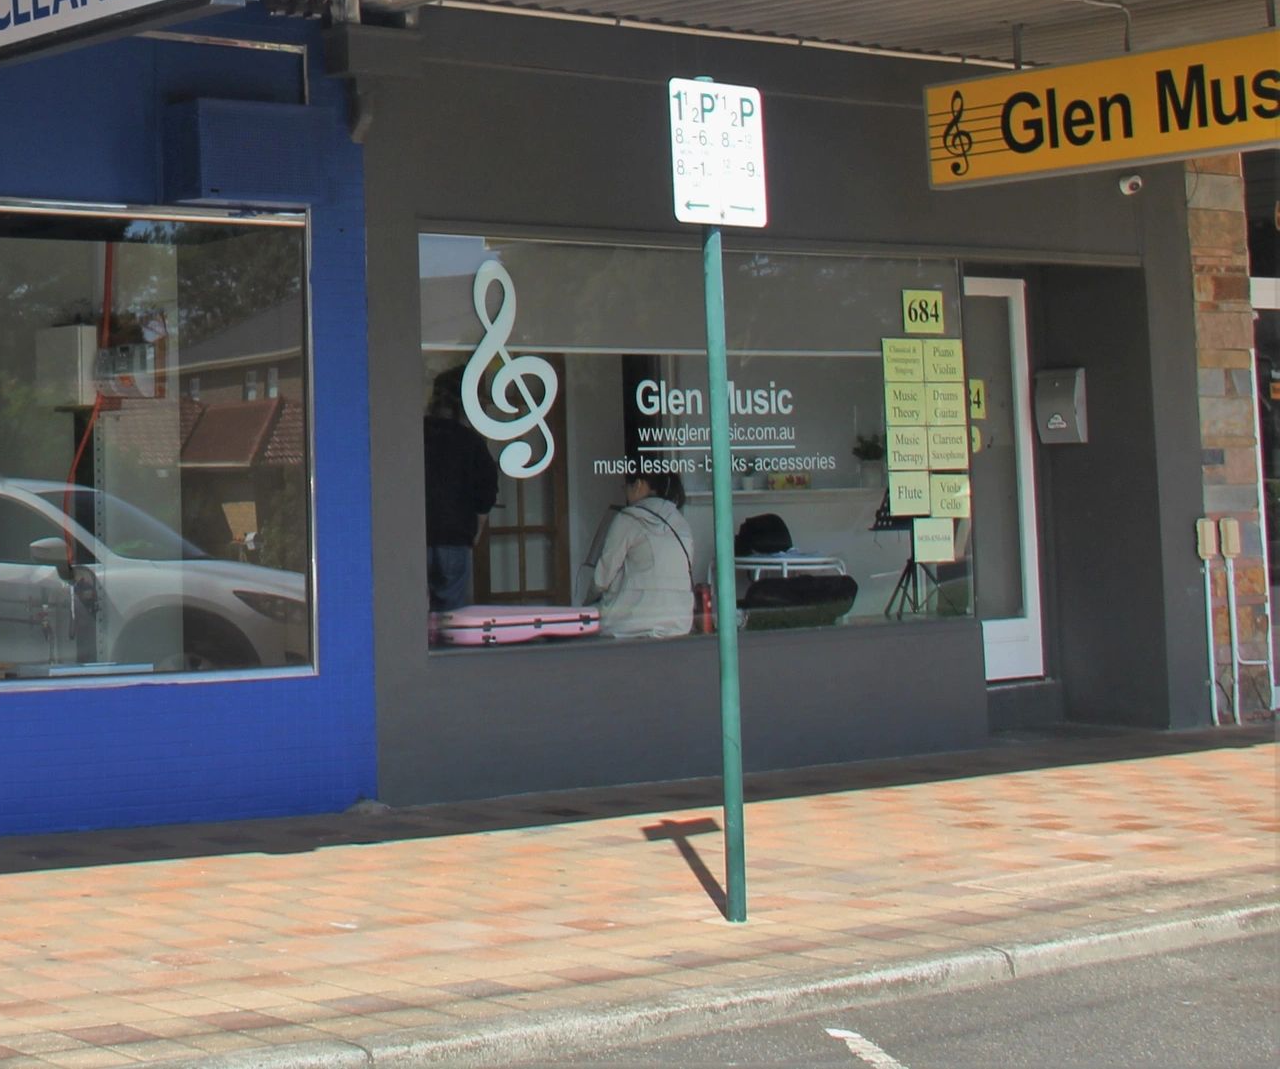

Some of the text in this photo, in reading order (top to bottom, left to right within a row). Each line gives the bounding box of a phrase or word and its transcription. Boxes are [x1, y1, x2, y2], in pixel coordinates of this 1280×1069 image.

[1000, 63, 1280, 154] Glen Mus
[908, 299, 940, 324] 684
[933, 347, 955, 357] Piano
[932, 364, 957, 375] Violin
[636, 379, 703, 415] Glen
[893, 390, 918, 401] Music
[932, 390, 958, 401] Drums
[893, 407, 920, 420] Theory
[934, 408, 958, 418] Guitar
[895, 434, 920, 445] Music
[932, 435, 963, 445] Clarinet
[892, 451, 924, 465] Therapy
[594, 455, 637, 474] music
[898, 485, 922, 500] Flute
[940, 482, 962, 493] Viola
[940, 498, 961, 509] Cello
